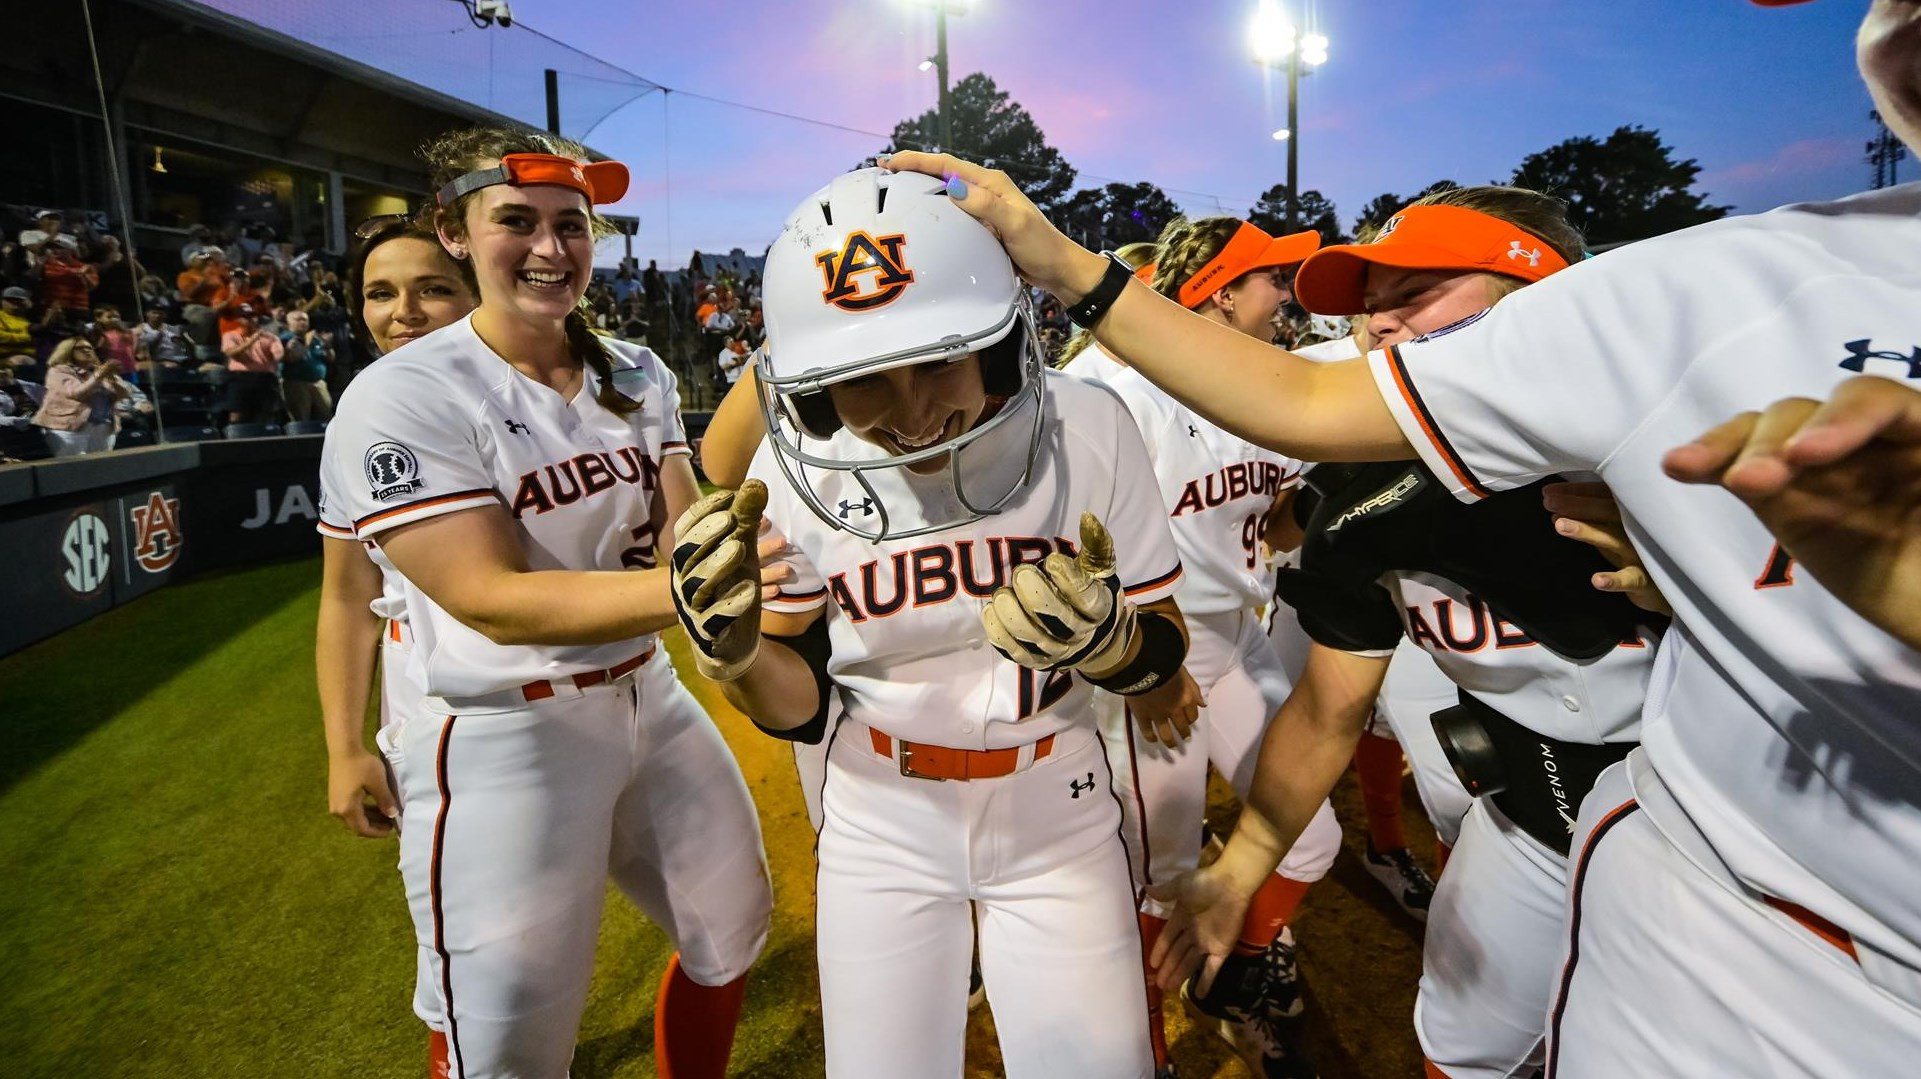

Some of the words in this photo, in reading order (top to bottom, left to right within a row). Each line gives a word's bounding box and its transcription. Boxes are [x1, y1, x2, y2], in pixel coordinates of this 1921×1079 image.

[62, 514, 111, 593] SEC
[828, 536, 1079, 623] AUBUR
[1540, 743, 1570, 809] VENOM
